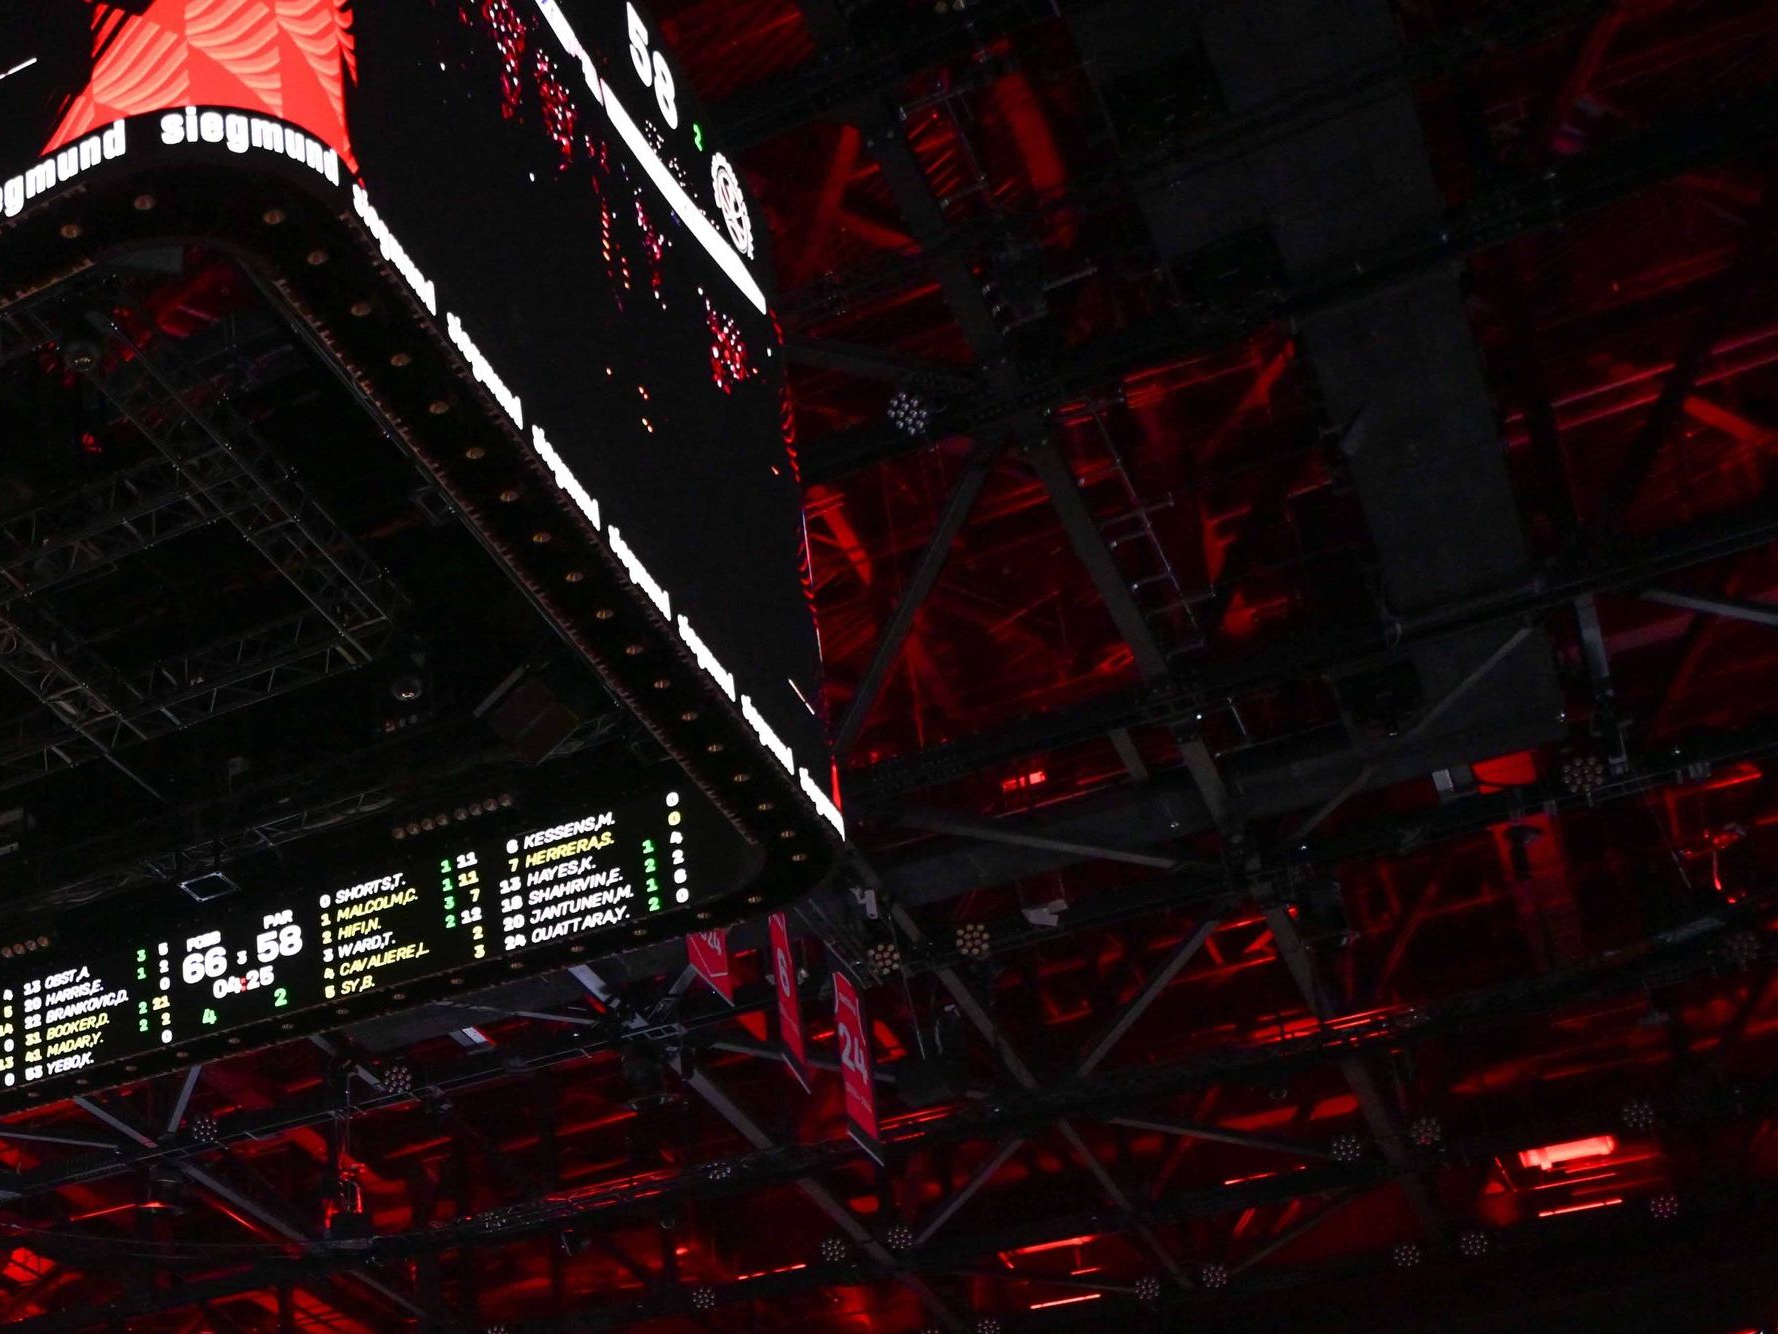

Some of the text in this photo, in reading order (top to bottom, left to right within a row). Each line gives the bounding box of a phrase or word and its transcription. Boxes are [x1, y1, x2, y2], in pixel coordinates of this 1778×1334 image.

[626, 0, 678, 130] 58
[161, 106, 340, 186] siegmund
[666, 792, 679, 807] 0
[508, 858, 519, 872] 7
[668, 811, 681, 826] 0
[672, 849, 684, 865] 2
[320, 894, 331, 909] 0
[456, 851, 478, 869] 11
[499, 876, 521, 894] 13
[676, 888, 689, 903] 0
[321, 913, 331, 927] 1
[458, 870, 479, 887] 11
[322, 931, 332, 945] 2
[470, 888, 480, 902] 7
[263, 909, 293, 929] PAR
[323, 948, 334, 963] 3
[461, 906, 482, 925] 12
[472, 926, 483, 940] 2
[503, 914, 525, 932] 20
[182, 924, 303, 984] 66 3 58
[474, 944, 485, 959] 3
[23, 997, 42, 1013] 20
[159, 959, 169, 974] 2
[23, 980, 41, 996] 13
[213, 965, 274, 999] 04:25
[24, 1014, 41, 1029] 22
[159, 976, 171, 990] 0
[25, 1032, 42, 1046] 31
[152, 995, 170, 1011] 21
[202, 988, 288, 1024] 4 2
[4, 1039, 14, 1052] 0
[25, 1048, 42, 1063] 41
[161, 1012, 171, 1026] 2
[161, 1029, 173, 1044] 0
[838, 1022, 868, 1084] 24
[5, 1073, 15, 1086] 0
